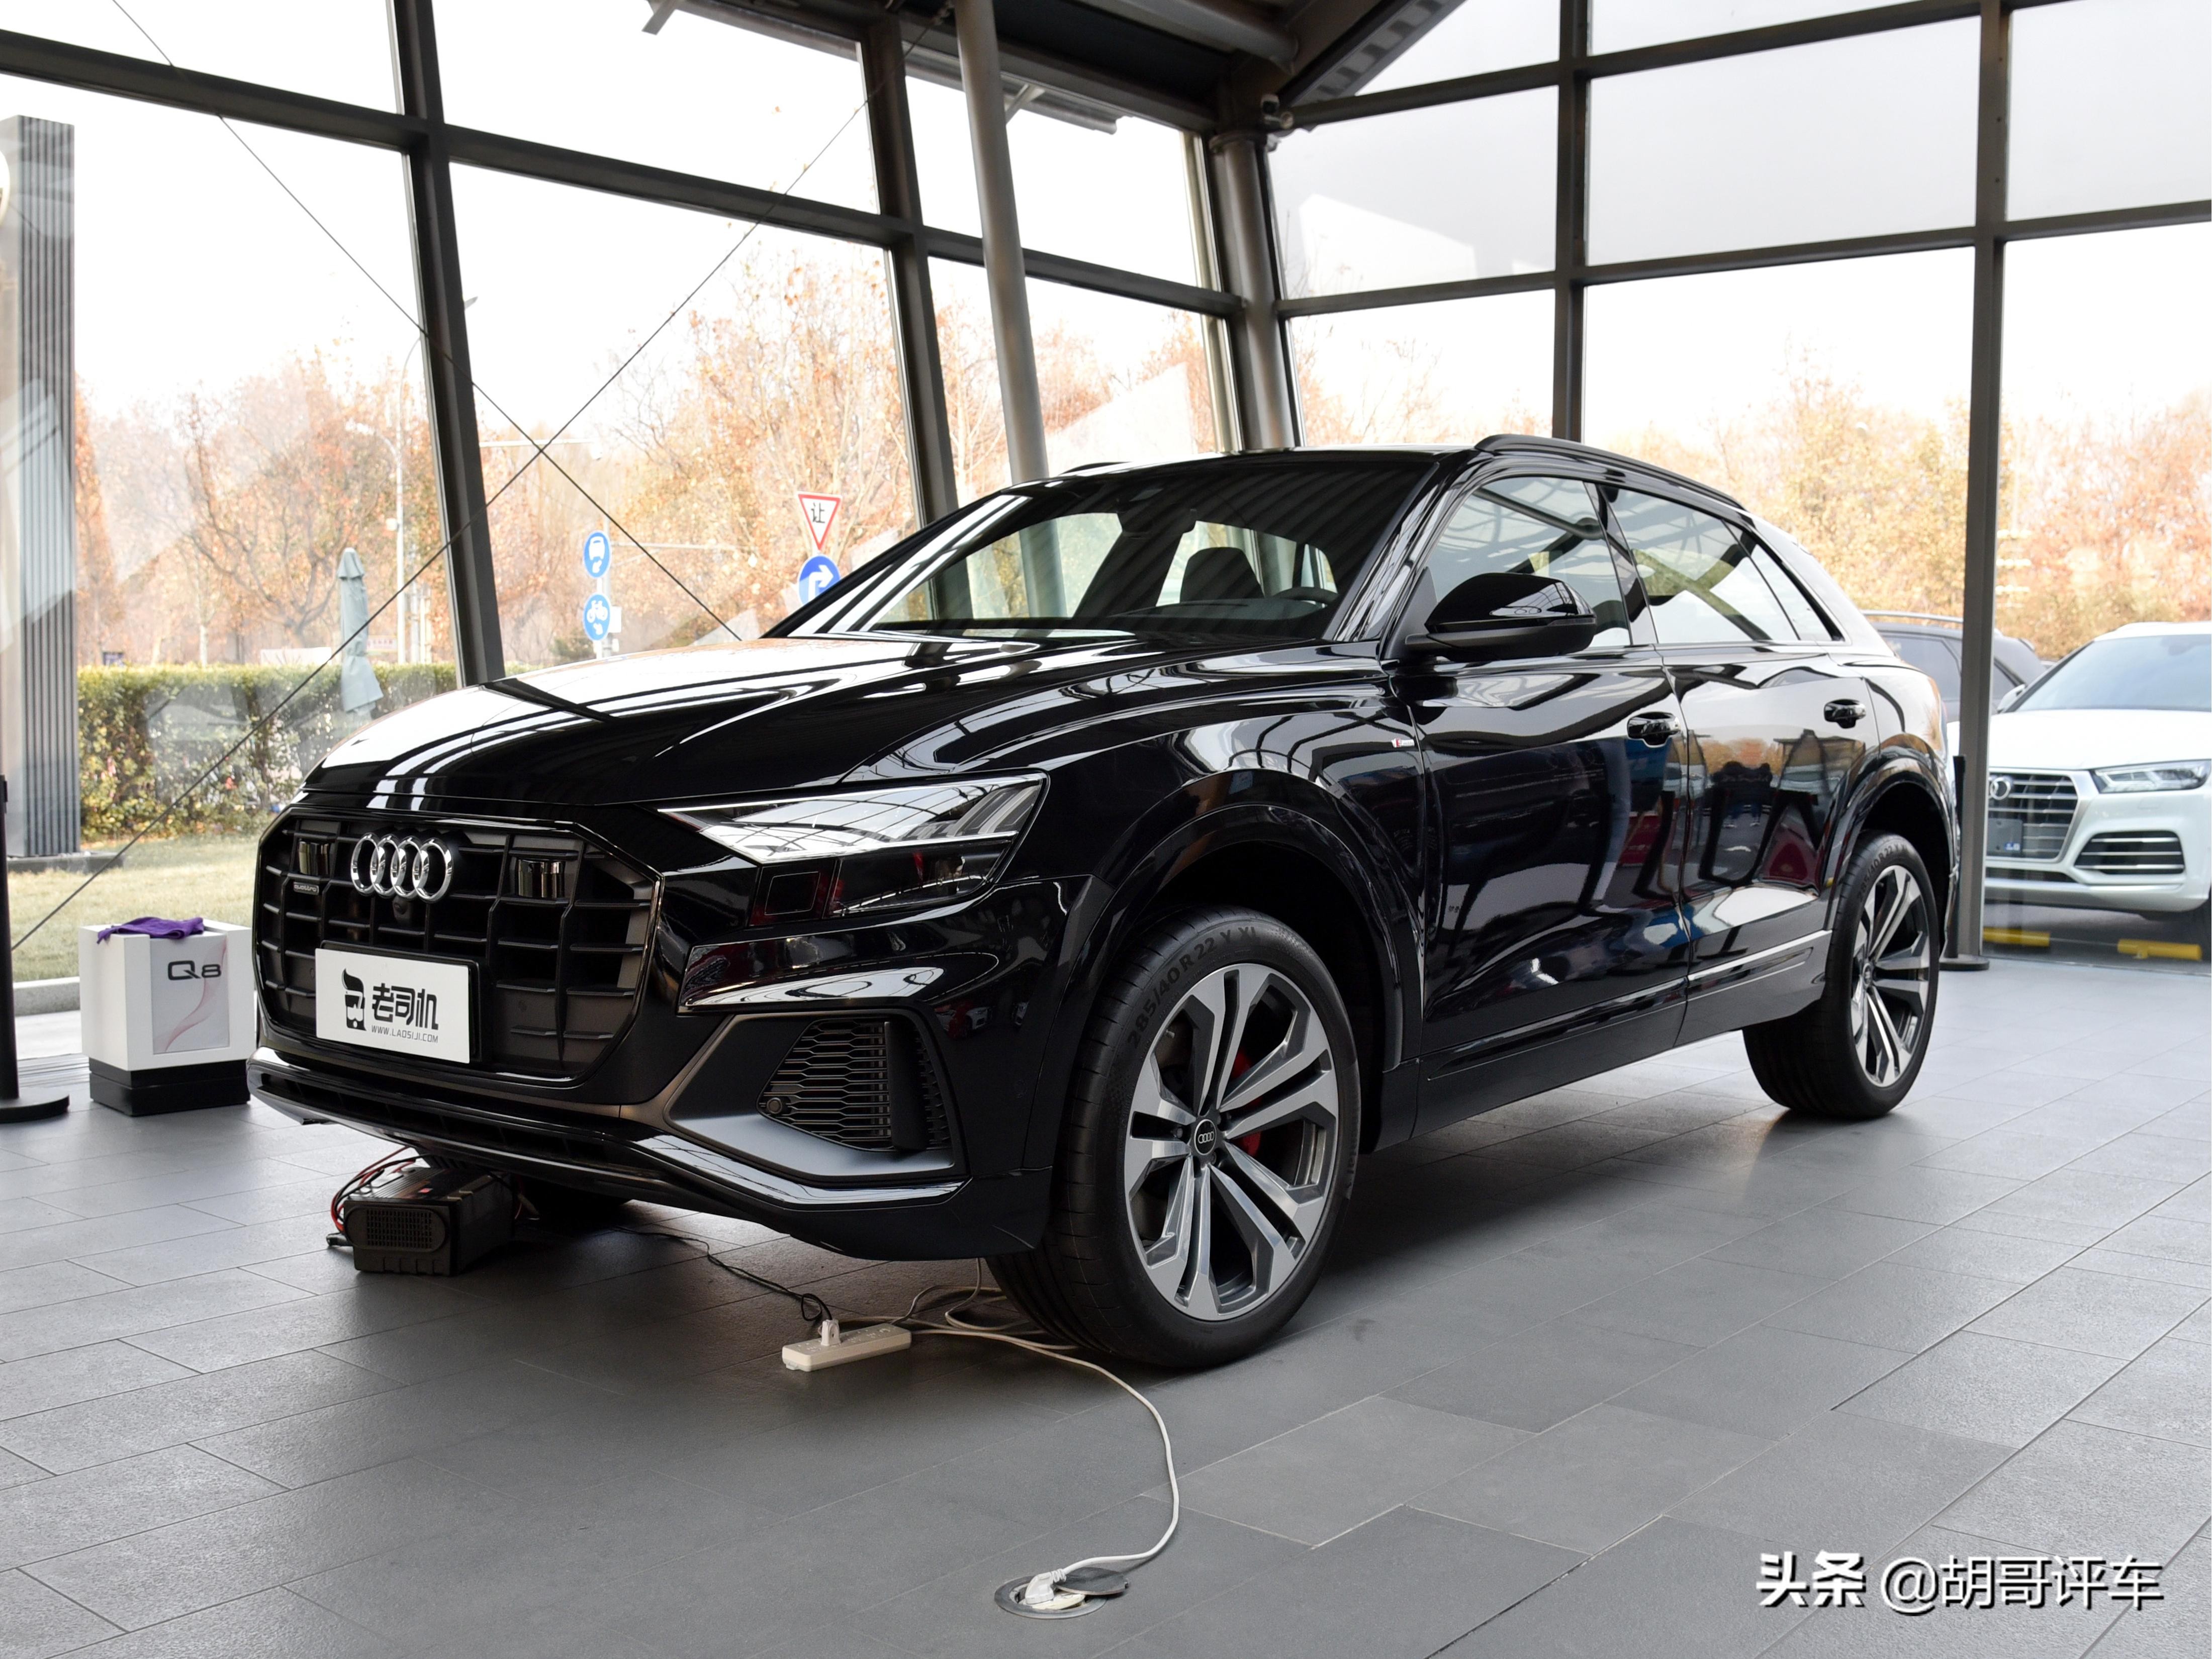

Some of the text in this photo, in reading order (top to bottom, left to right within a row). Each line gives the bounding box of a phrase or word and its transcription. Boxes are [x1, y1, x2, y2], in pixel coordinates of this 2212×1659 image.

[811, 502, 825, 523] 让
[167, 960, 222, 980] Q8
[372, 982, 439, 1030] 老司机
[372, 1025, 438, 1044] WWW.LAOSIJI.COM
